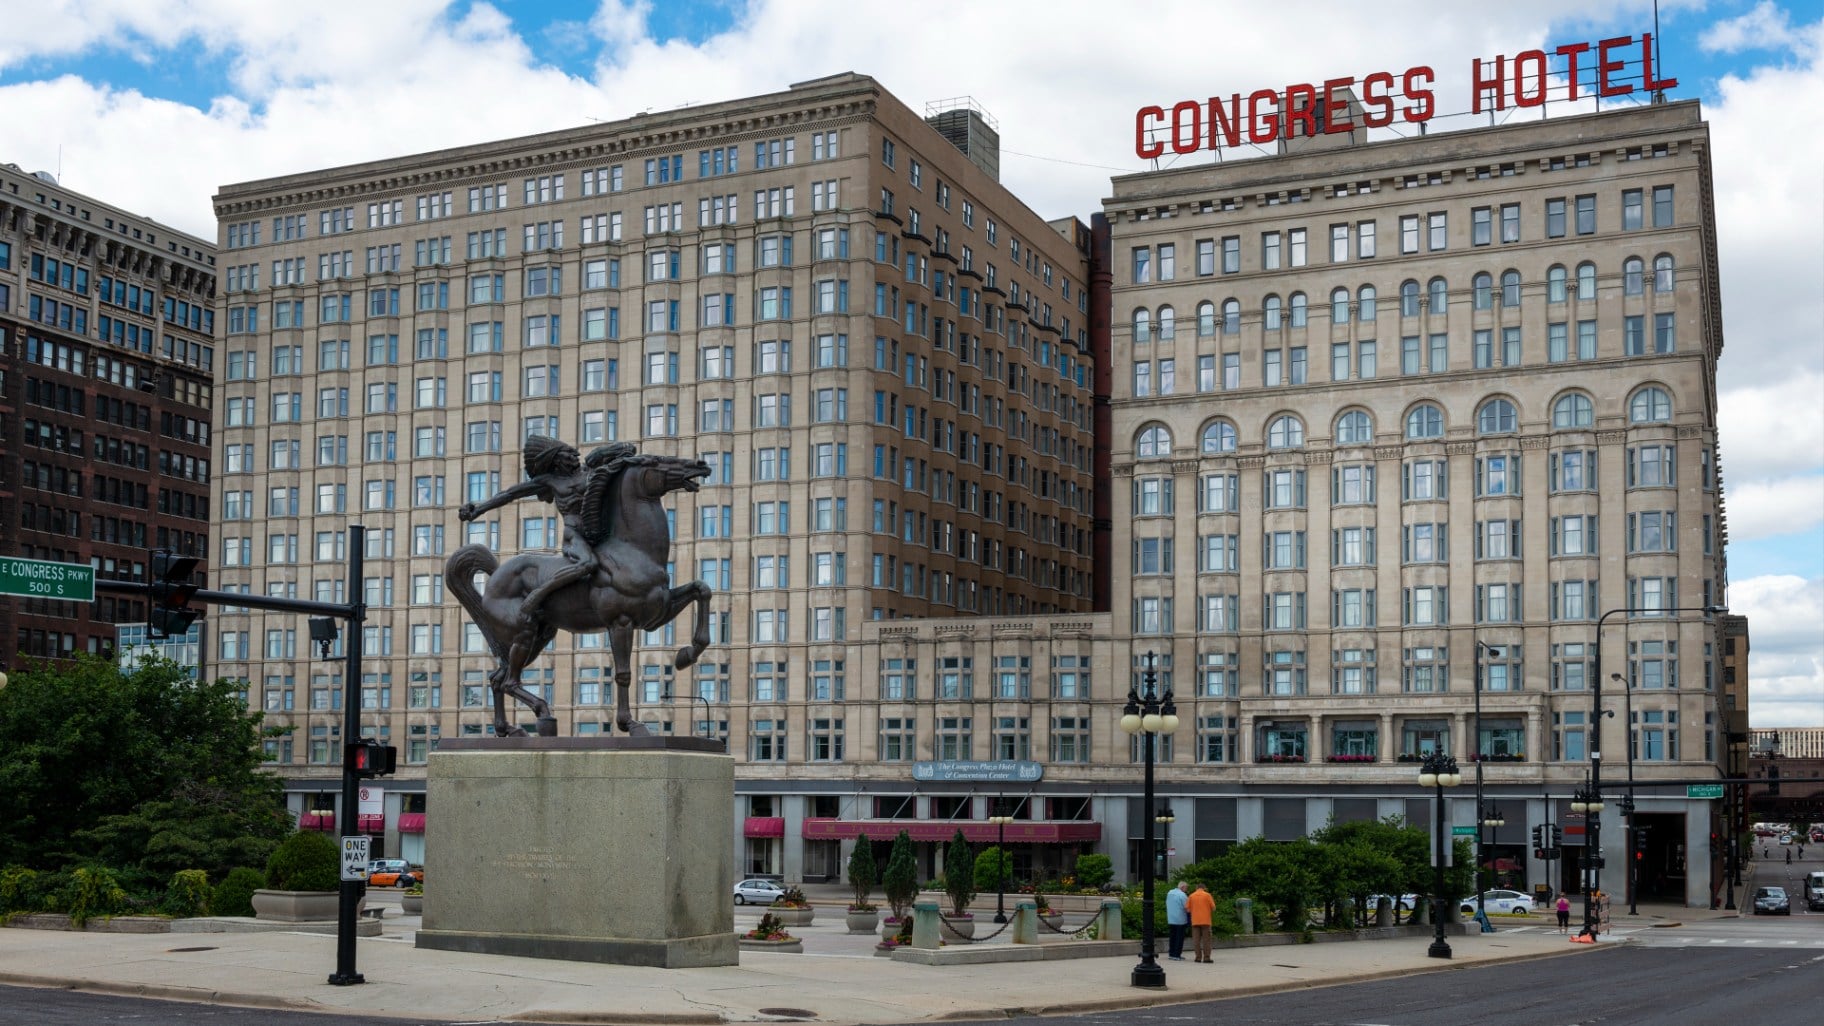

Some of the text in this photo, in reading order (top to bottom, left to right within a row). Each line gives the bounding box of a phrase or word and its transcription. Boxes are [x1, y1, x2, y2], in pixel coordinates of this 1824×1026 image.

[1135, 33, 1679, 160] CONGRESS HOTEL
[2, 562, 90, 582] E CONGRESS PKWY
[29, 581, 64, 595] 500 S
[345, 840, 367, 851] ONE
[345, 852, 366, 863] WAY
